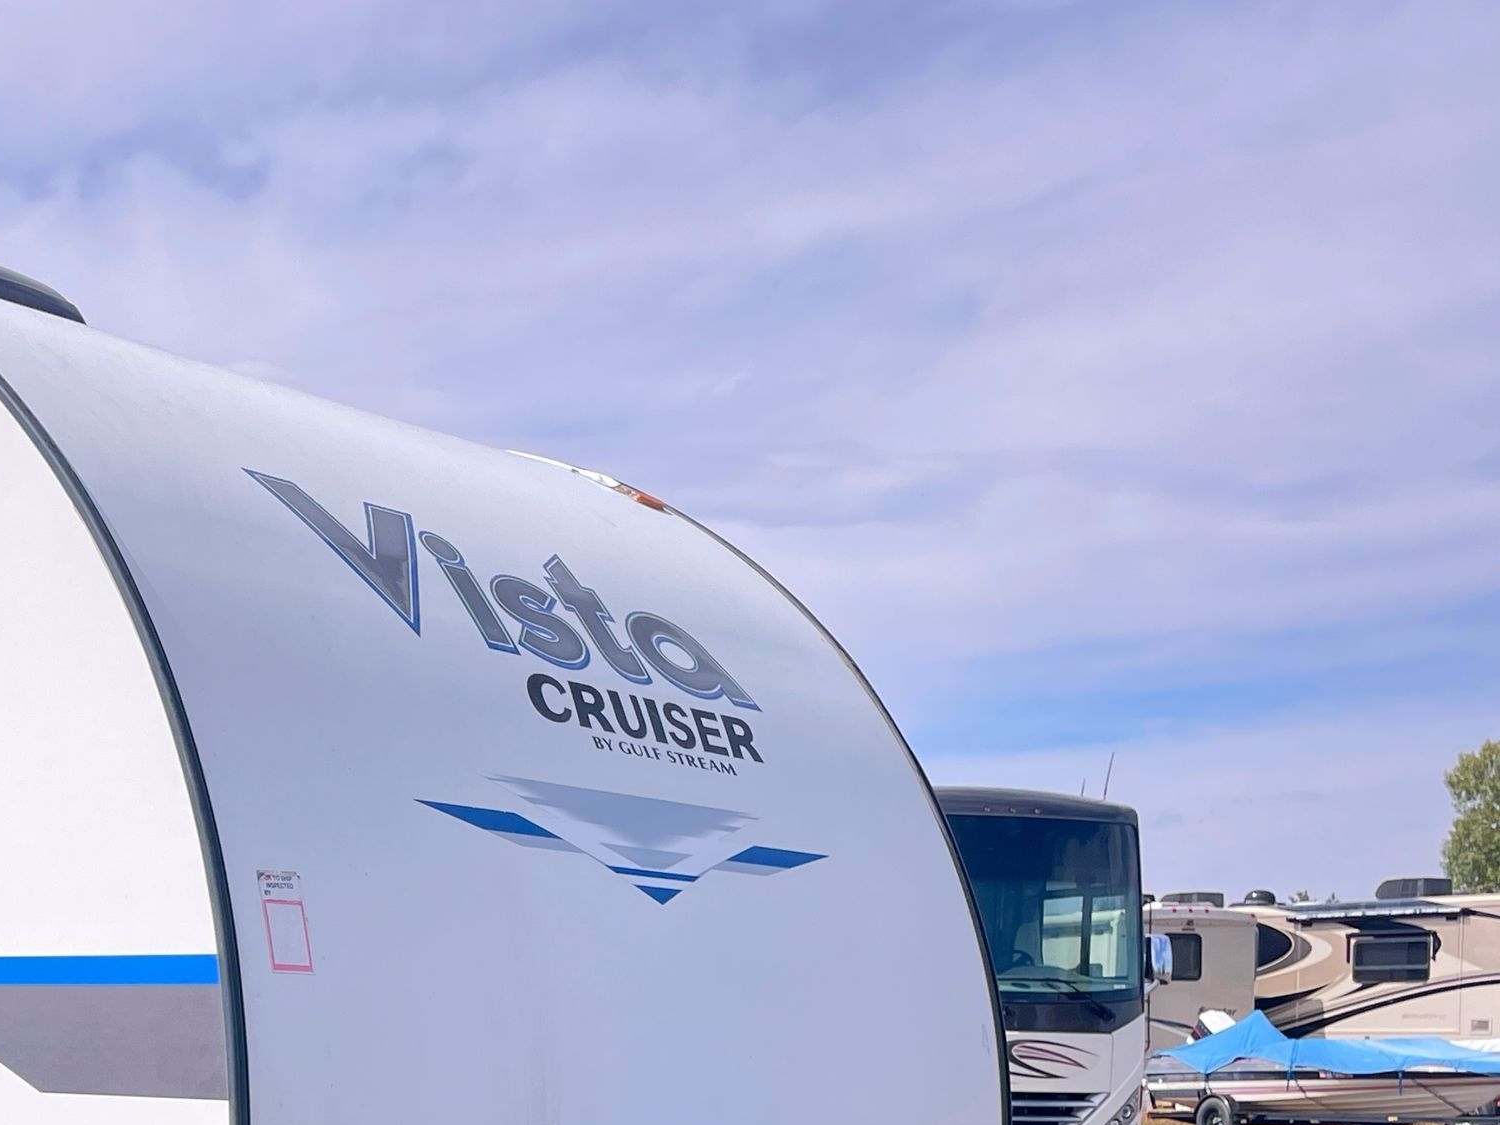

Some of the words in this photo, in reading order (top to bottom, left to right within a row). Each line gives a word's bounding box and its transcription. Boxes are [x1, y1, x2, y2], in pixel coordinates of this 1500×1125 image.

[241, 468, 763, 712] Vista
[526, 673, 764, 763] CRUISER
[592, 736, 613, 751] BY
[618, 741, 662, 760] GULF
[666, 751, 738, 776] STREAM
